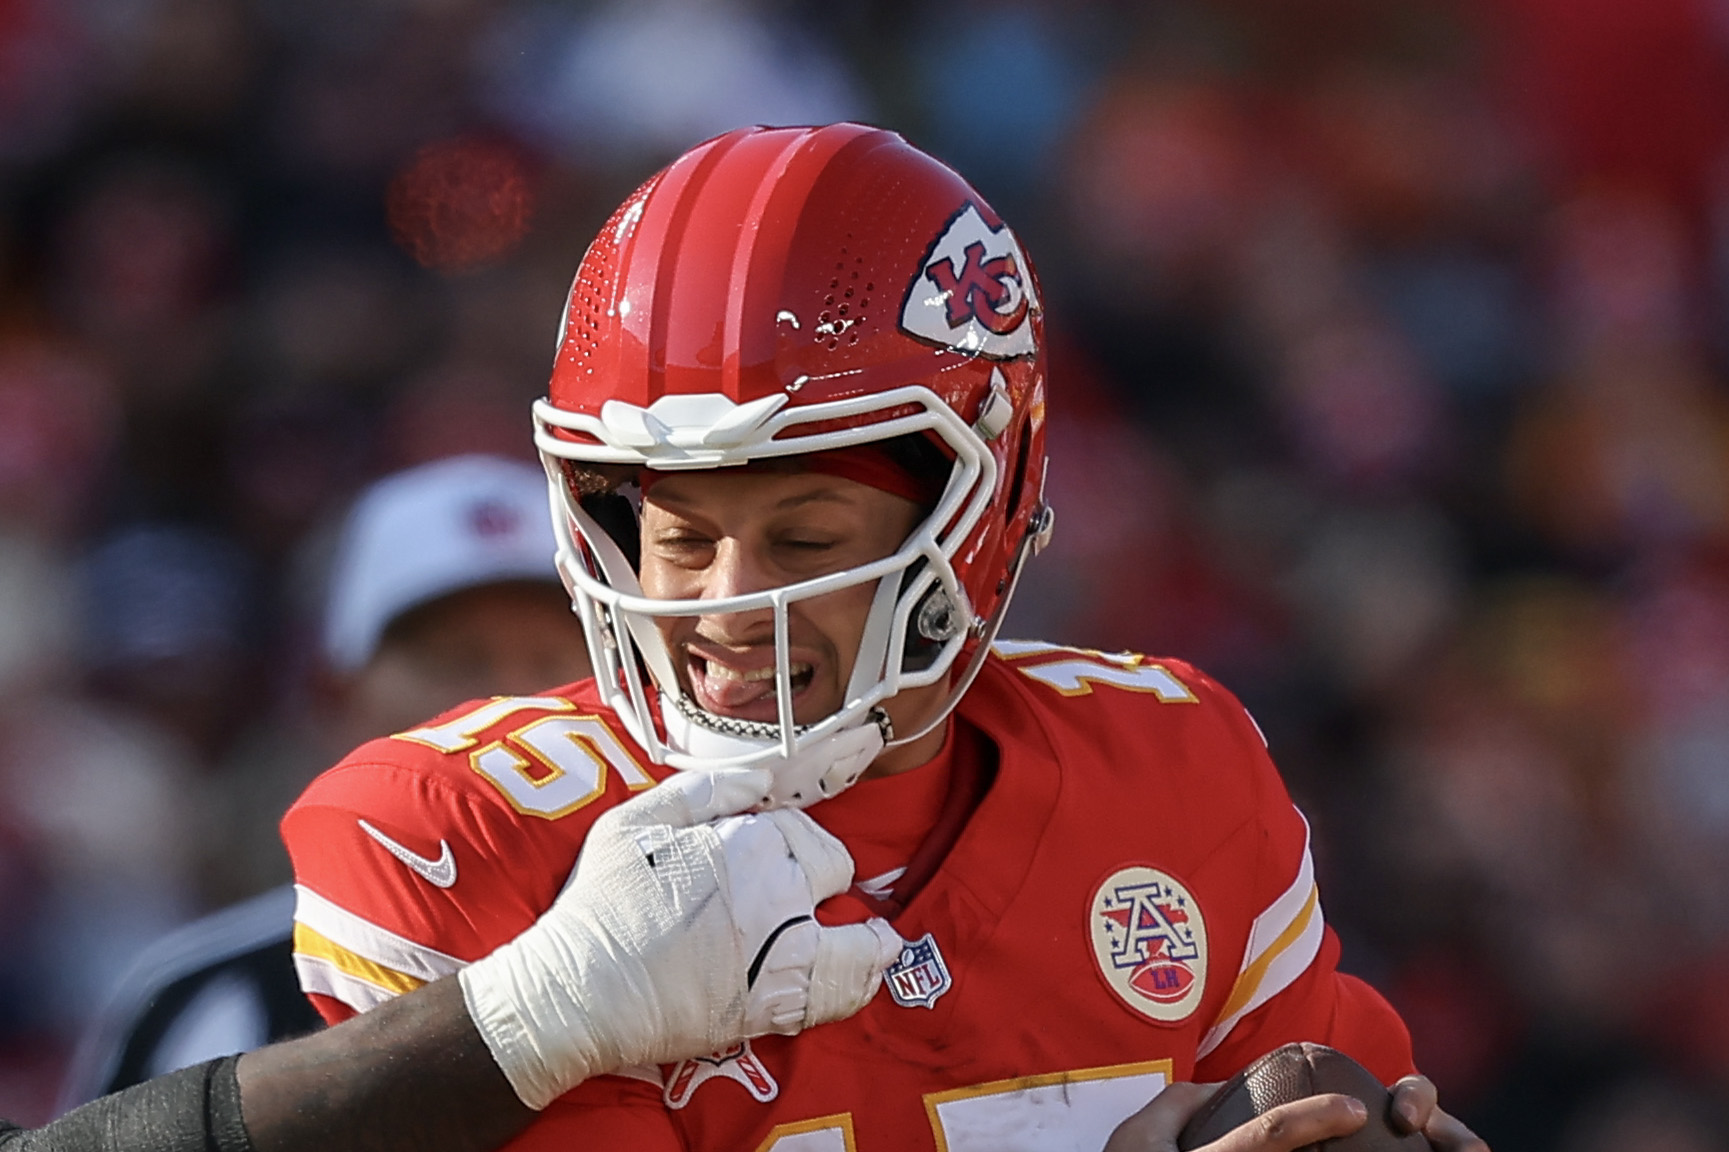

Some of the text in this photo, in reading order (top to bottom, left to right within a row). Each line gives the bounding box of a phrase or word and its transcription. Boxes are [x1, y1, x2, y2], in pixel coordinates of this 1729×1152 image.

[925, 239, 1029, 335] KC
[389, 696, 658, 821] 15
[894, 963, 941, 998] NFL
